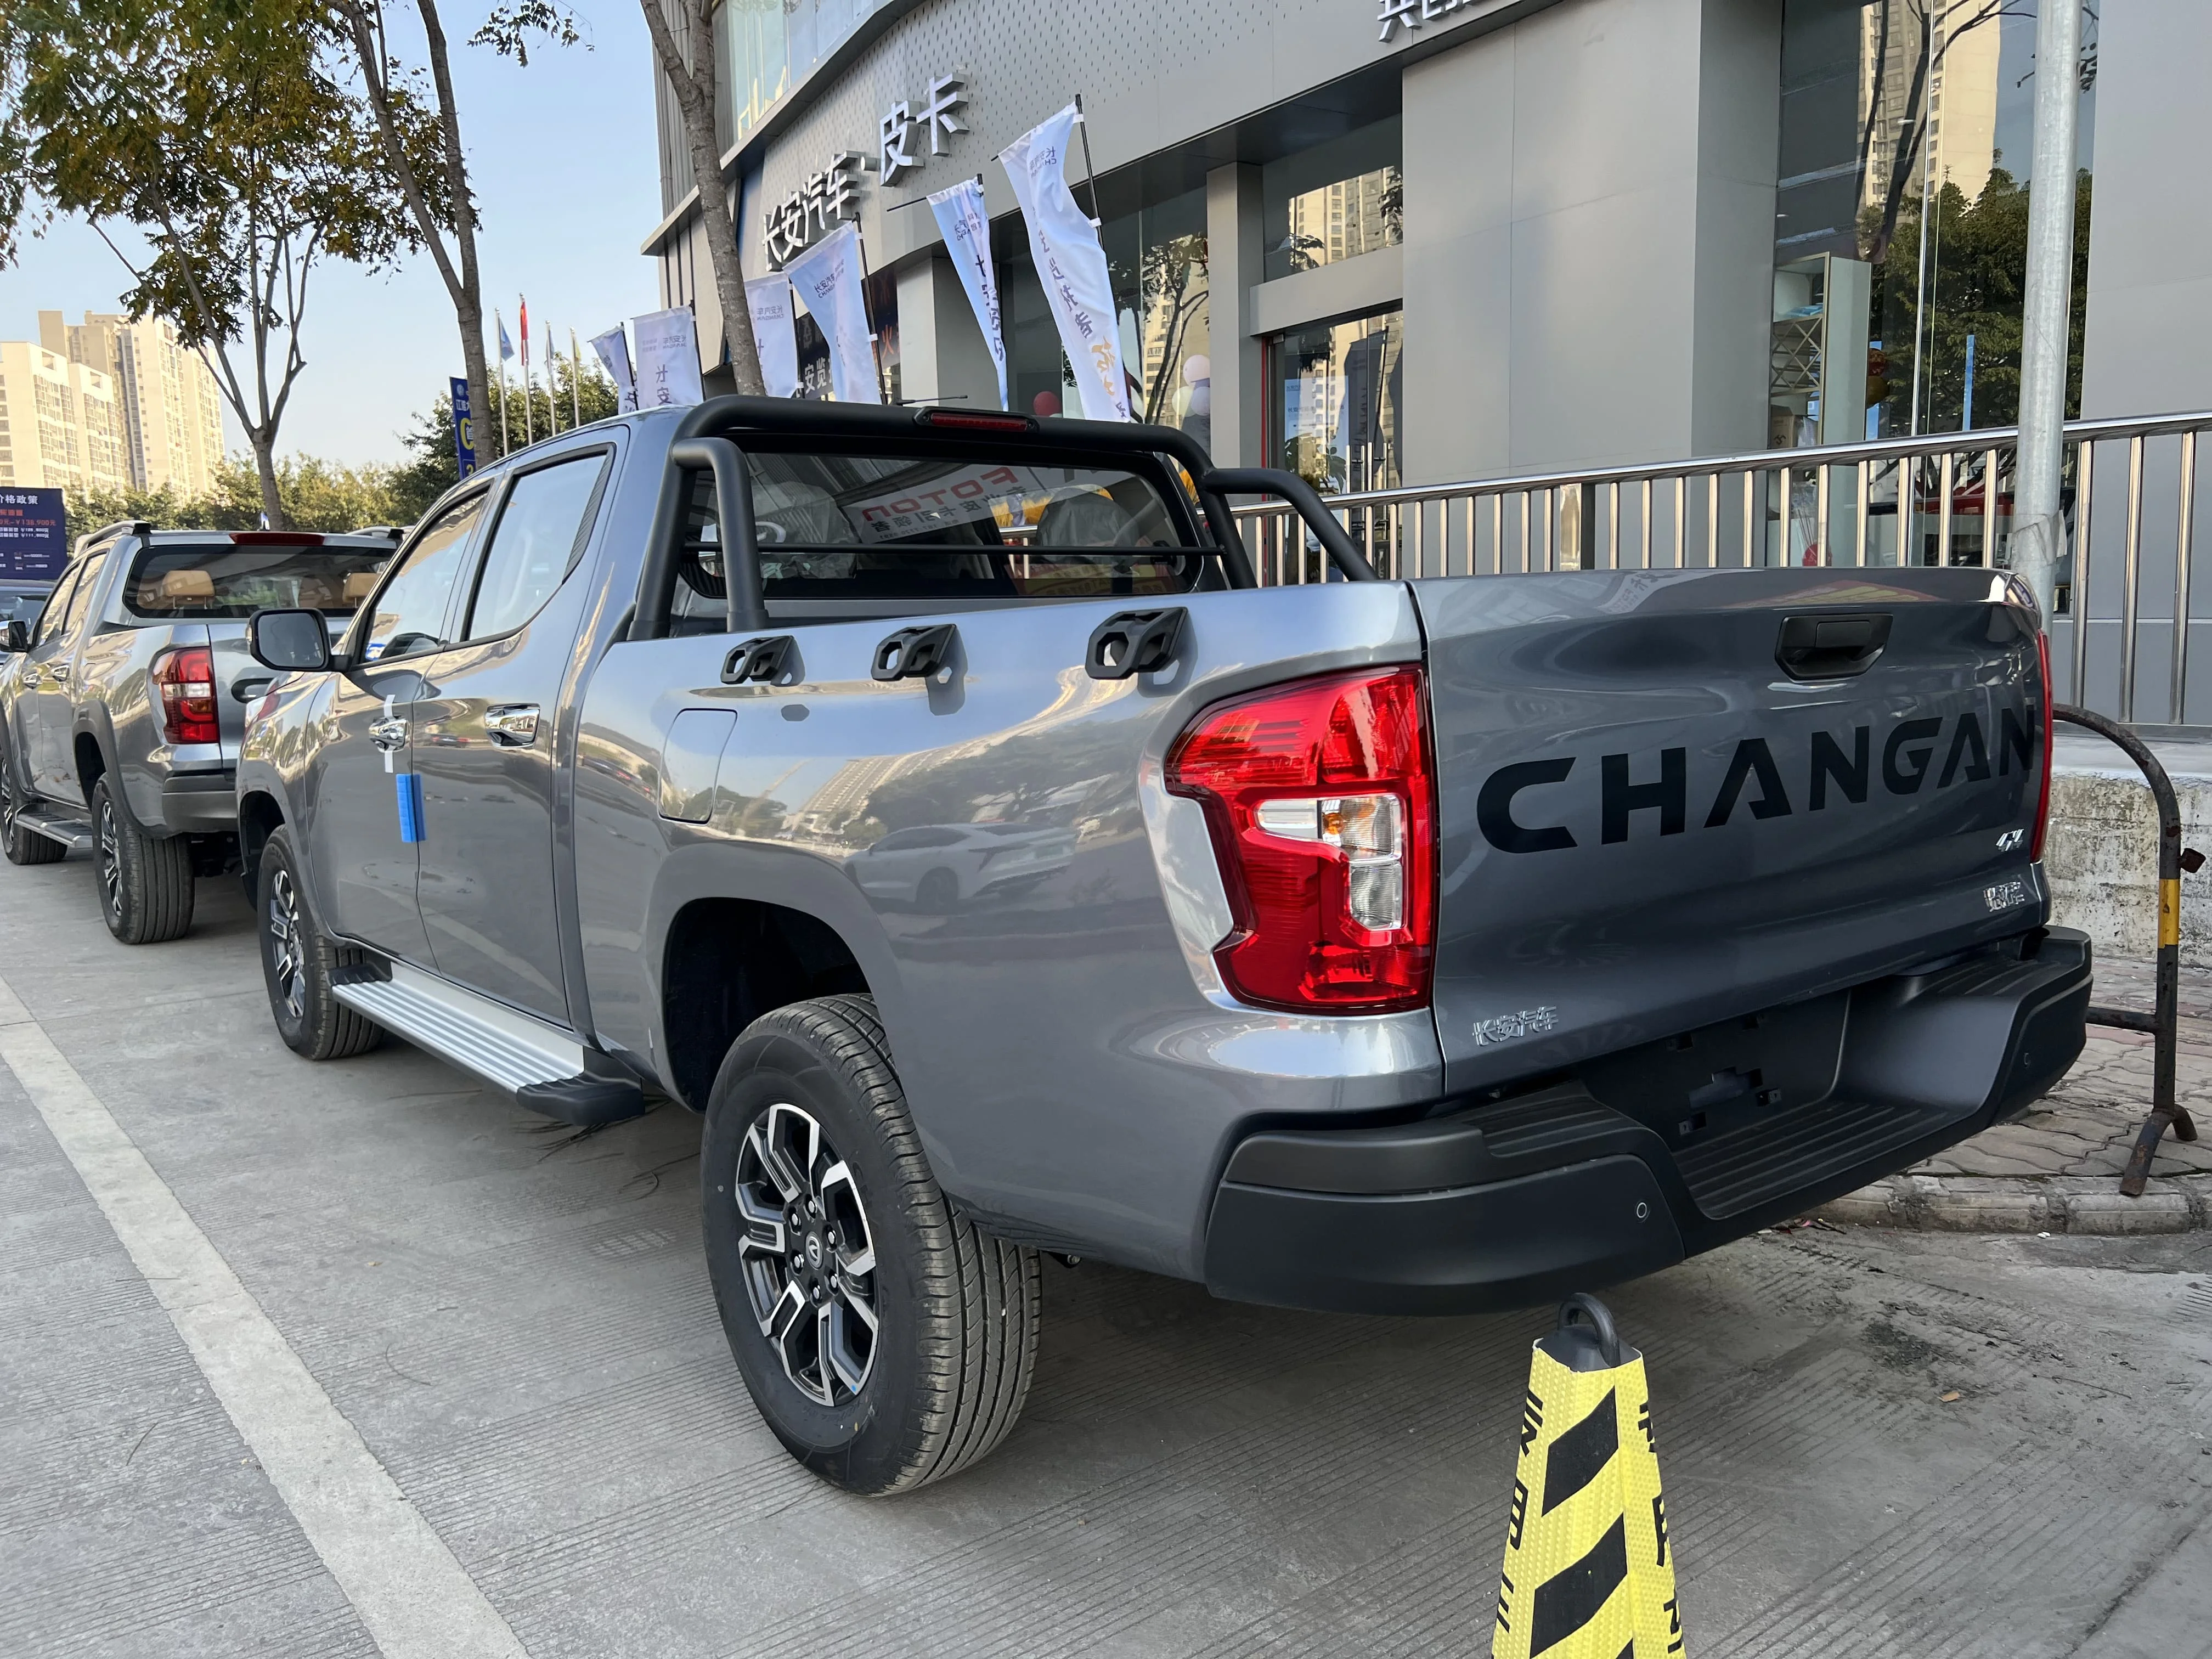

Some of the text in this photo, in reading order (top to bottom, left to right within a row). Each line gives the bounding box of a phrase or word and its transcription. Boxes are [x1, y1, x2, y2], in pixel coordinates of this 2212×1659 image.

[1476, 706, 2035, 854] CHANGAN
[1472, 1006, 1559, 1046] 长安汽车
